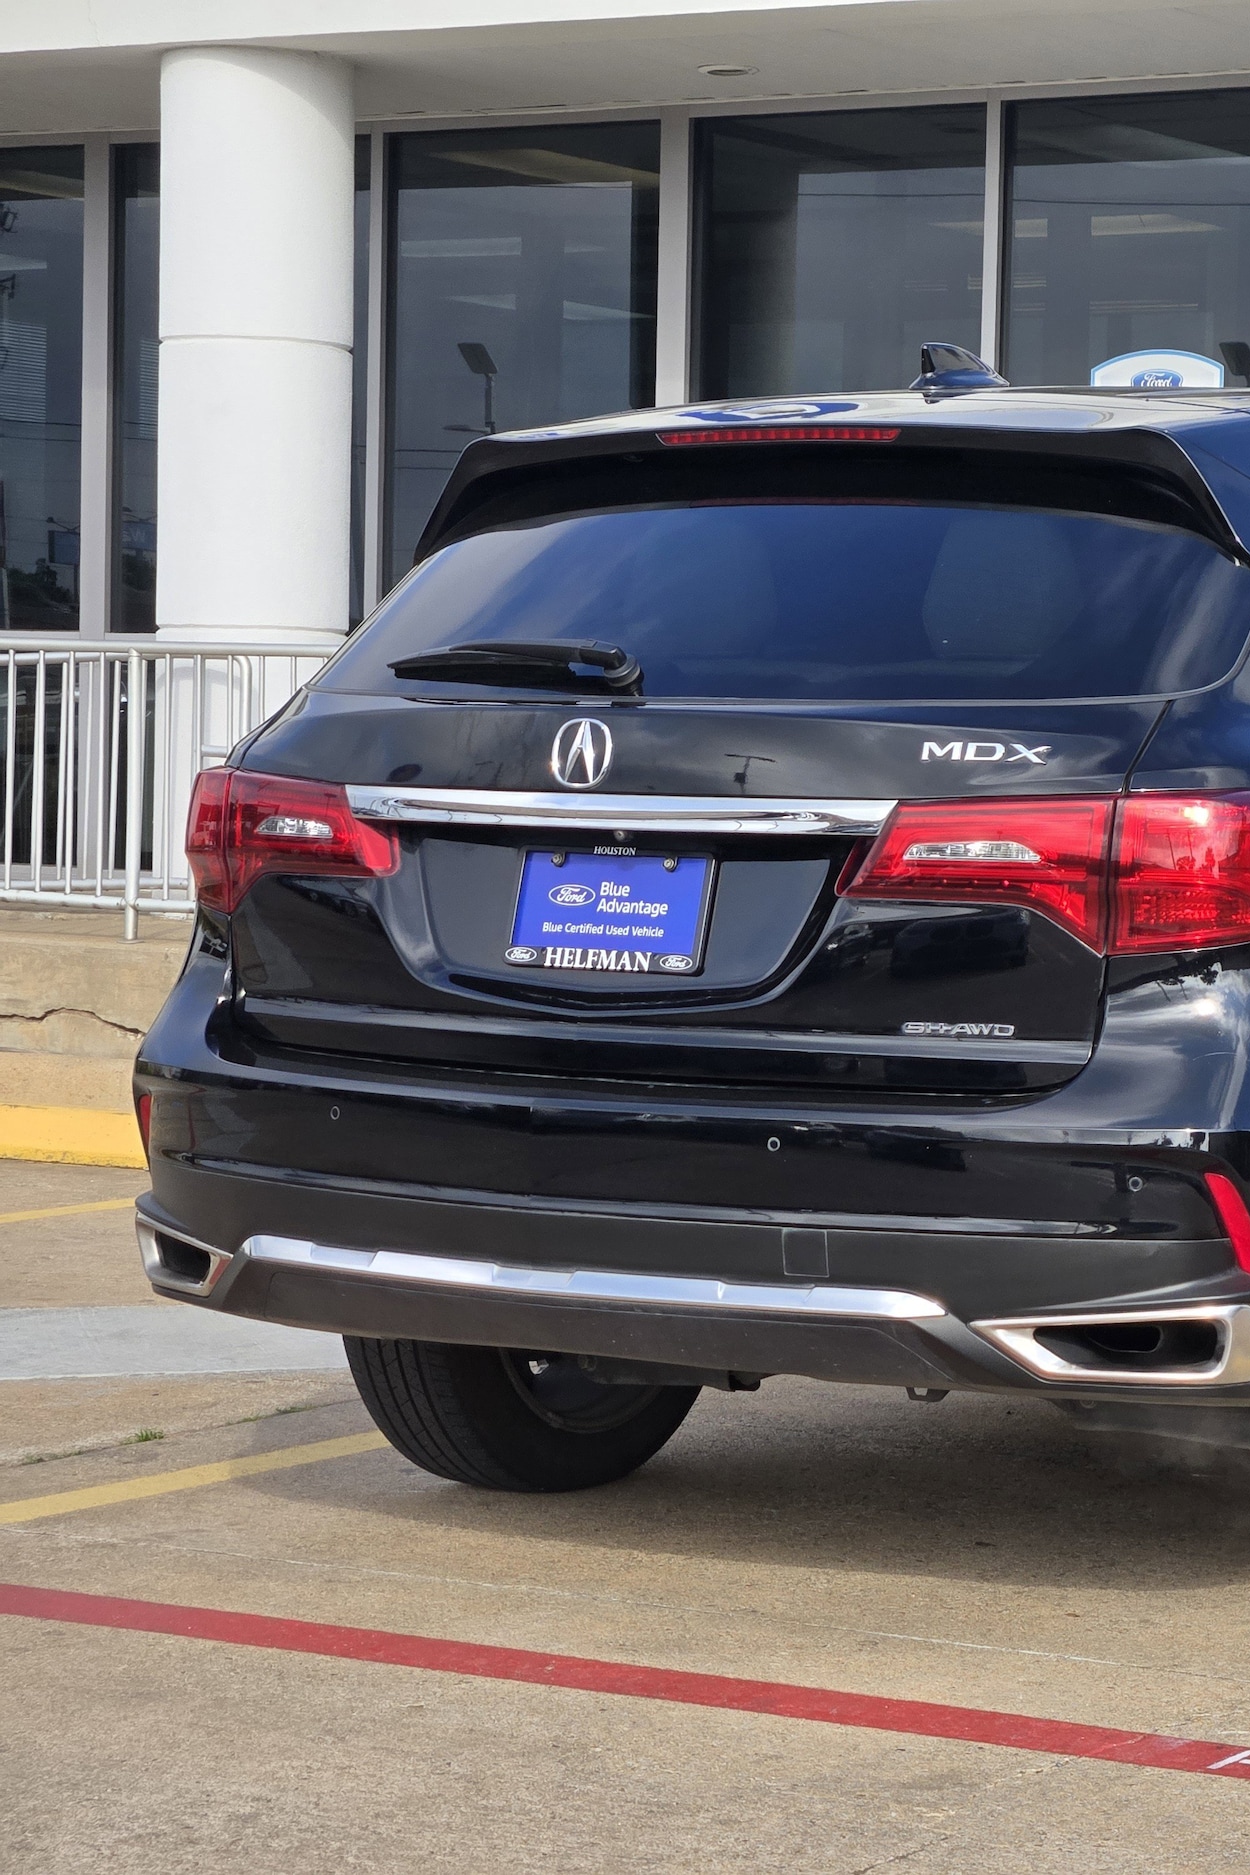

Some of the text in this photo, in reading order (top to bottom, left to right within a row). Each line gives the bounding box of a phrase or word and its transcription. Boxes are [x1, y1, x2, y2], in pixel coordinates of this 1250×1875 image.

[921, 741, 1052, 765] MDX
[593, 845, 637, 856] HOUSTON
[556, 886, 588, 903] Ford
[600, 881, 630, 897] Blue
[596, 897, 669, 918] Advantage
[542, 921, 665, 938] Blue Certified Used Vehicle
[543, 946, 652, 972] HELFMAN
